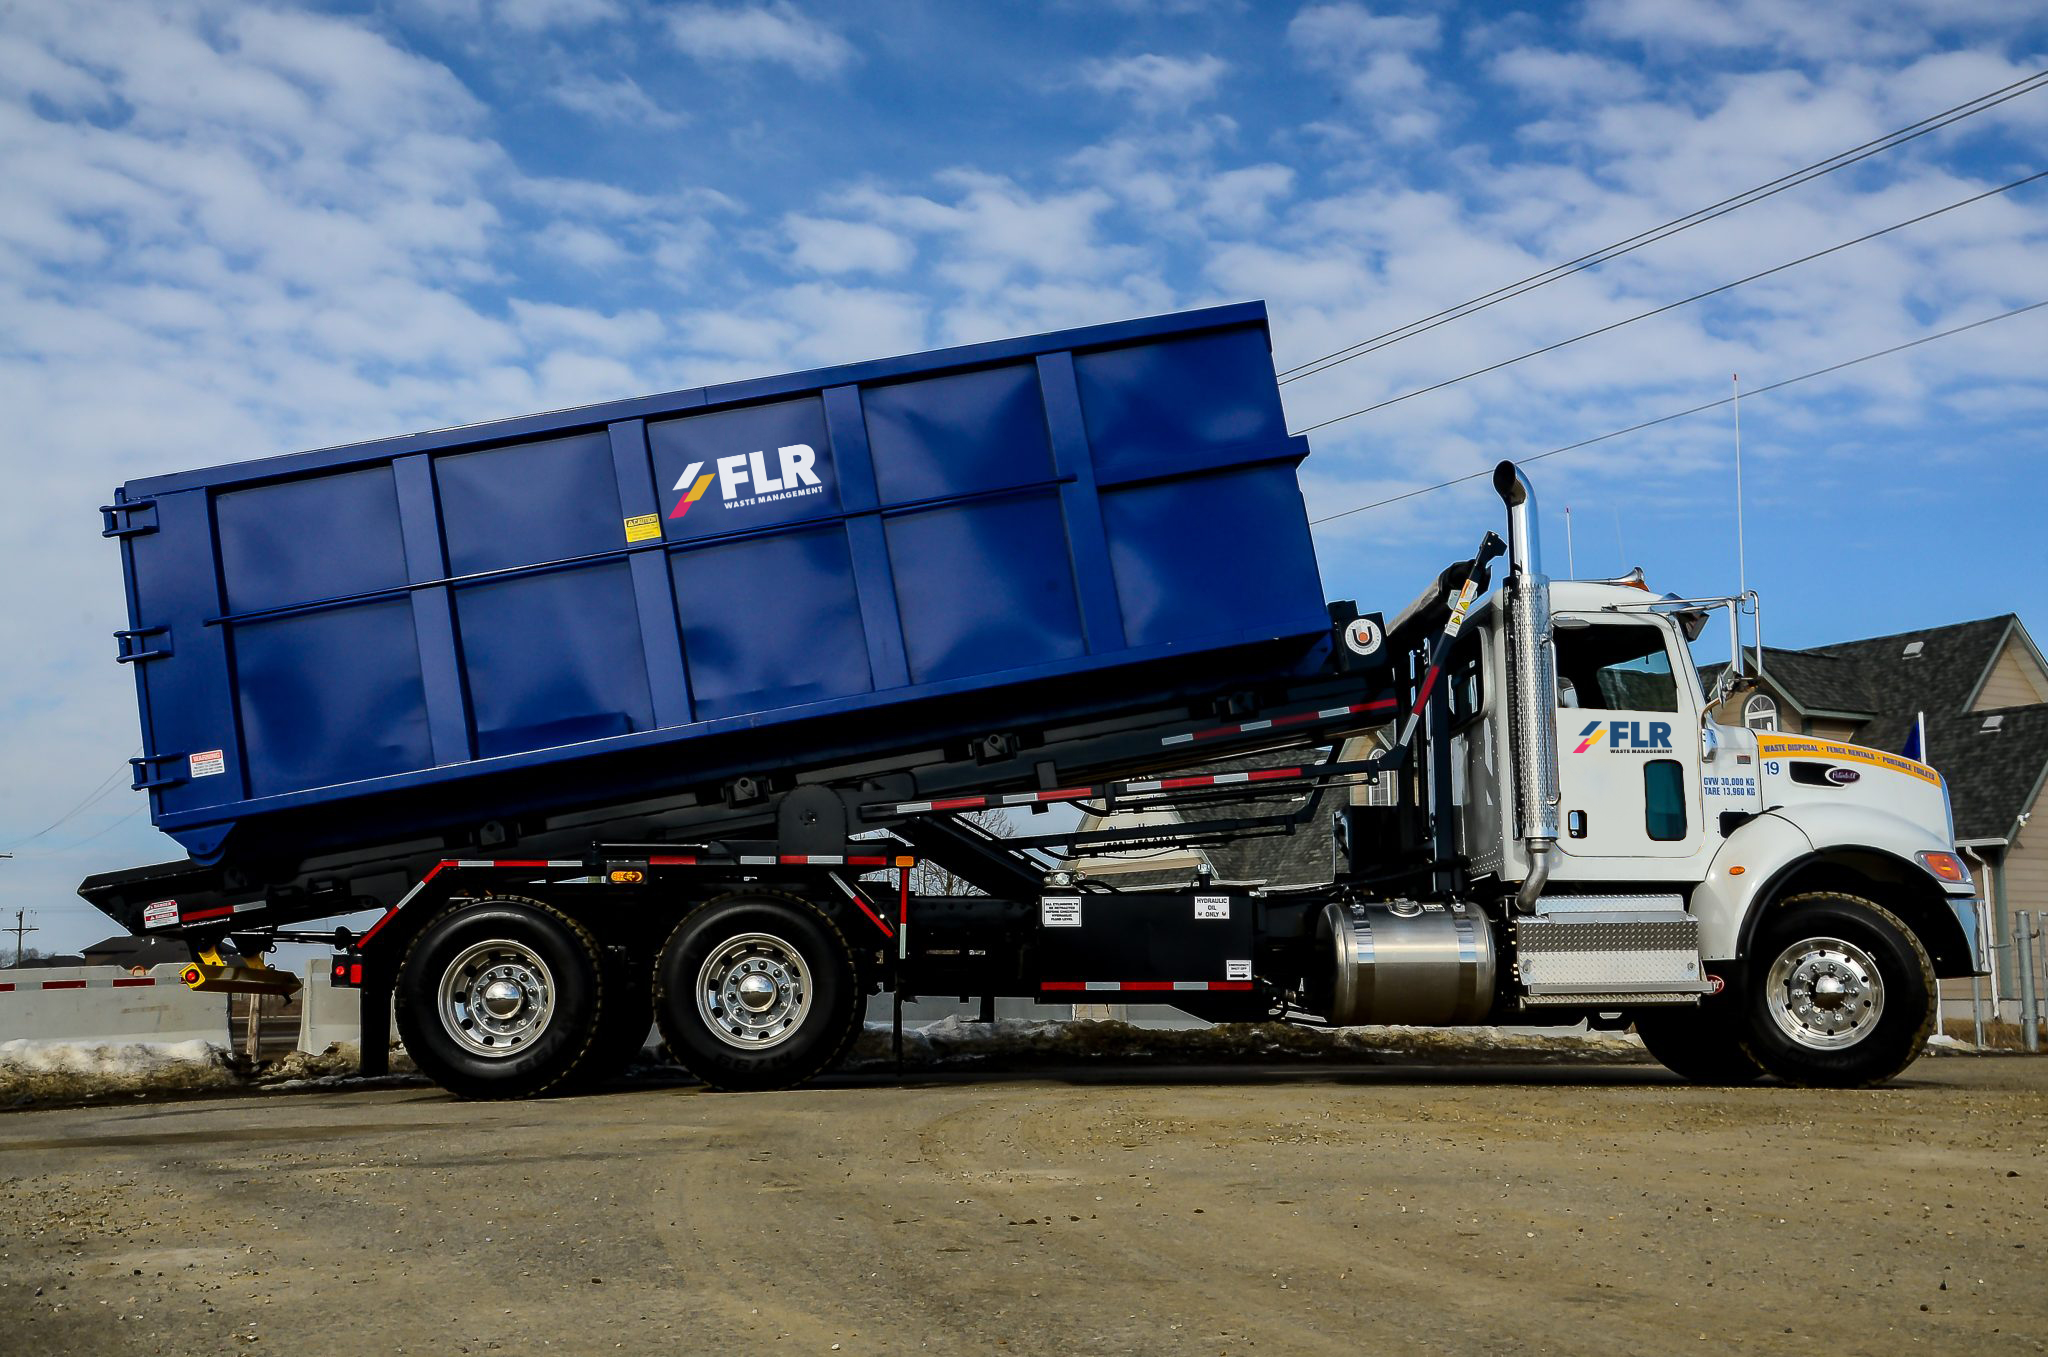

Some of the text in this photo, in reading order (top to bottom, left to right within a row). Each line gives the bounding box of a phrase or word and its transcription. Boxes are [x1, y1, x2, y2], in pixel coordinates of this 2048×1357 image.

[717, 444, 821, 500] FLR
[724, 486, 823, 509] WASTE MANAGEMENT
[1610, 721, 1672, 748] FLR
[1764, 744, 1786, 752] WASTE
[1788, 744, 1818, 752] DISPOSAL
[1826, 746, 1846, 754] FENCE
[1848, 749, 1875, 760] RENTALS
[1764, 761, 1779, 775] 19
[1704, 777, 1754, 786] GVW 30,000 KG
[1704, 787, 1755, 796] TARE 13,960 KG
